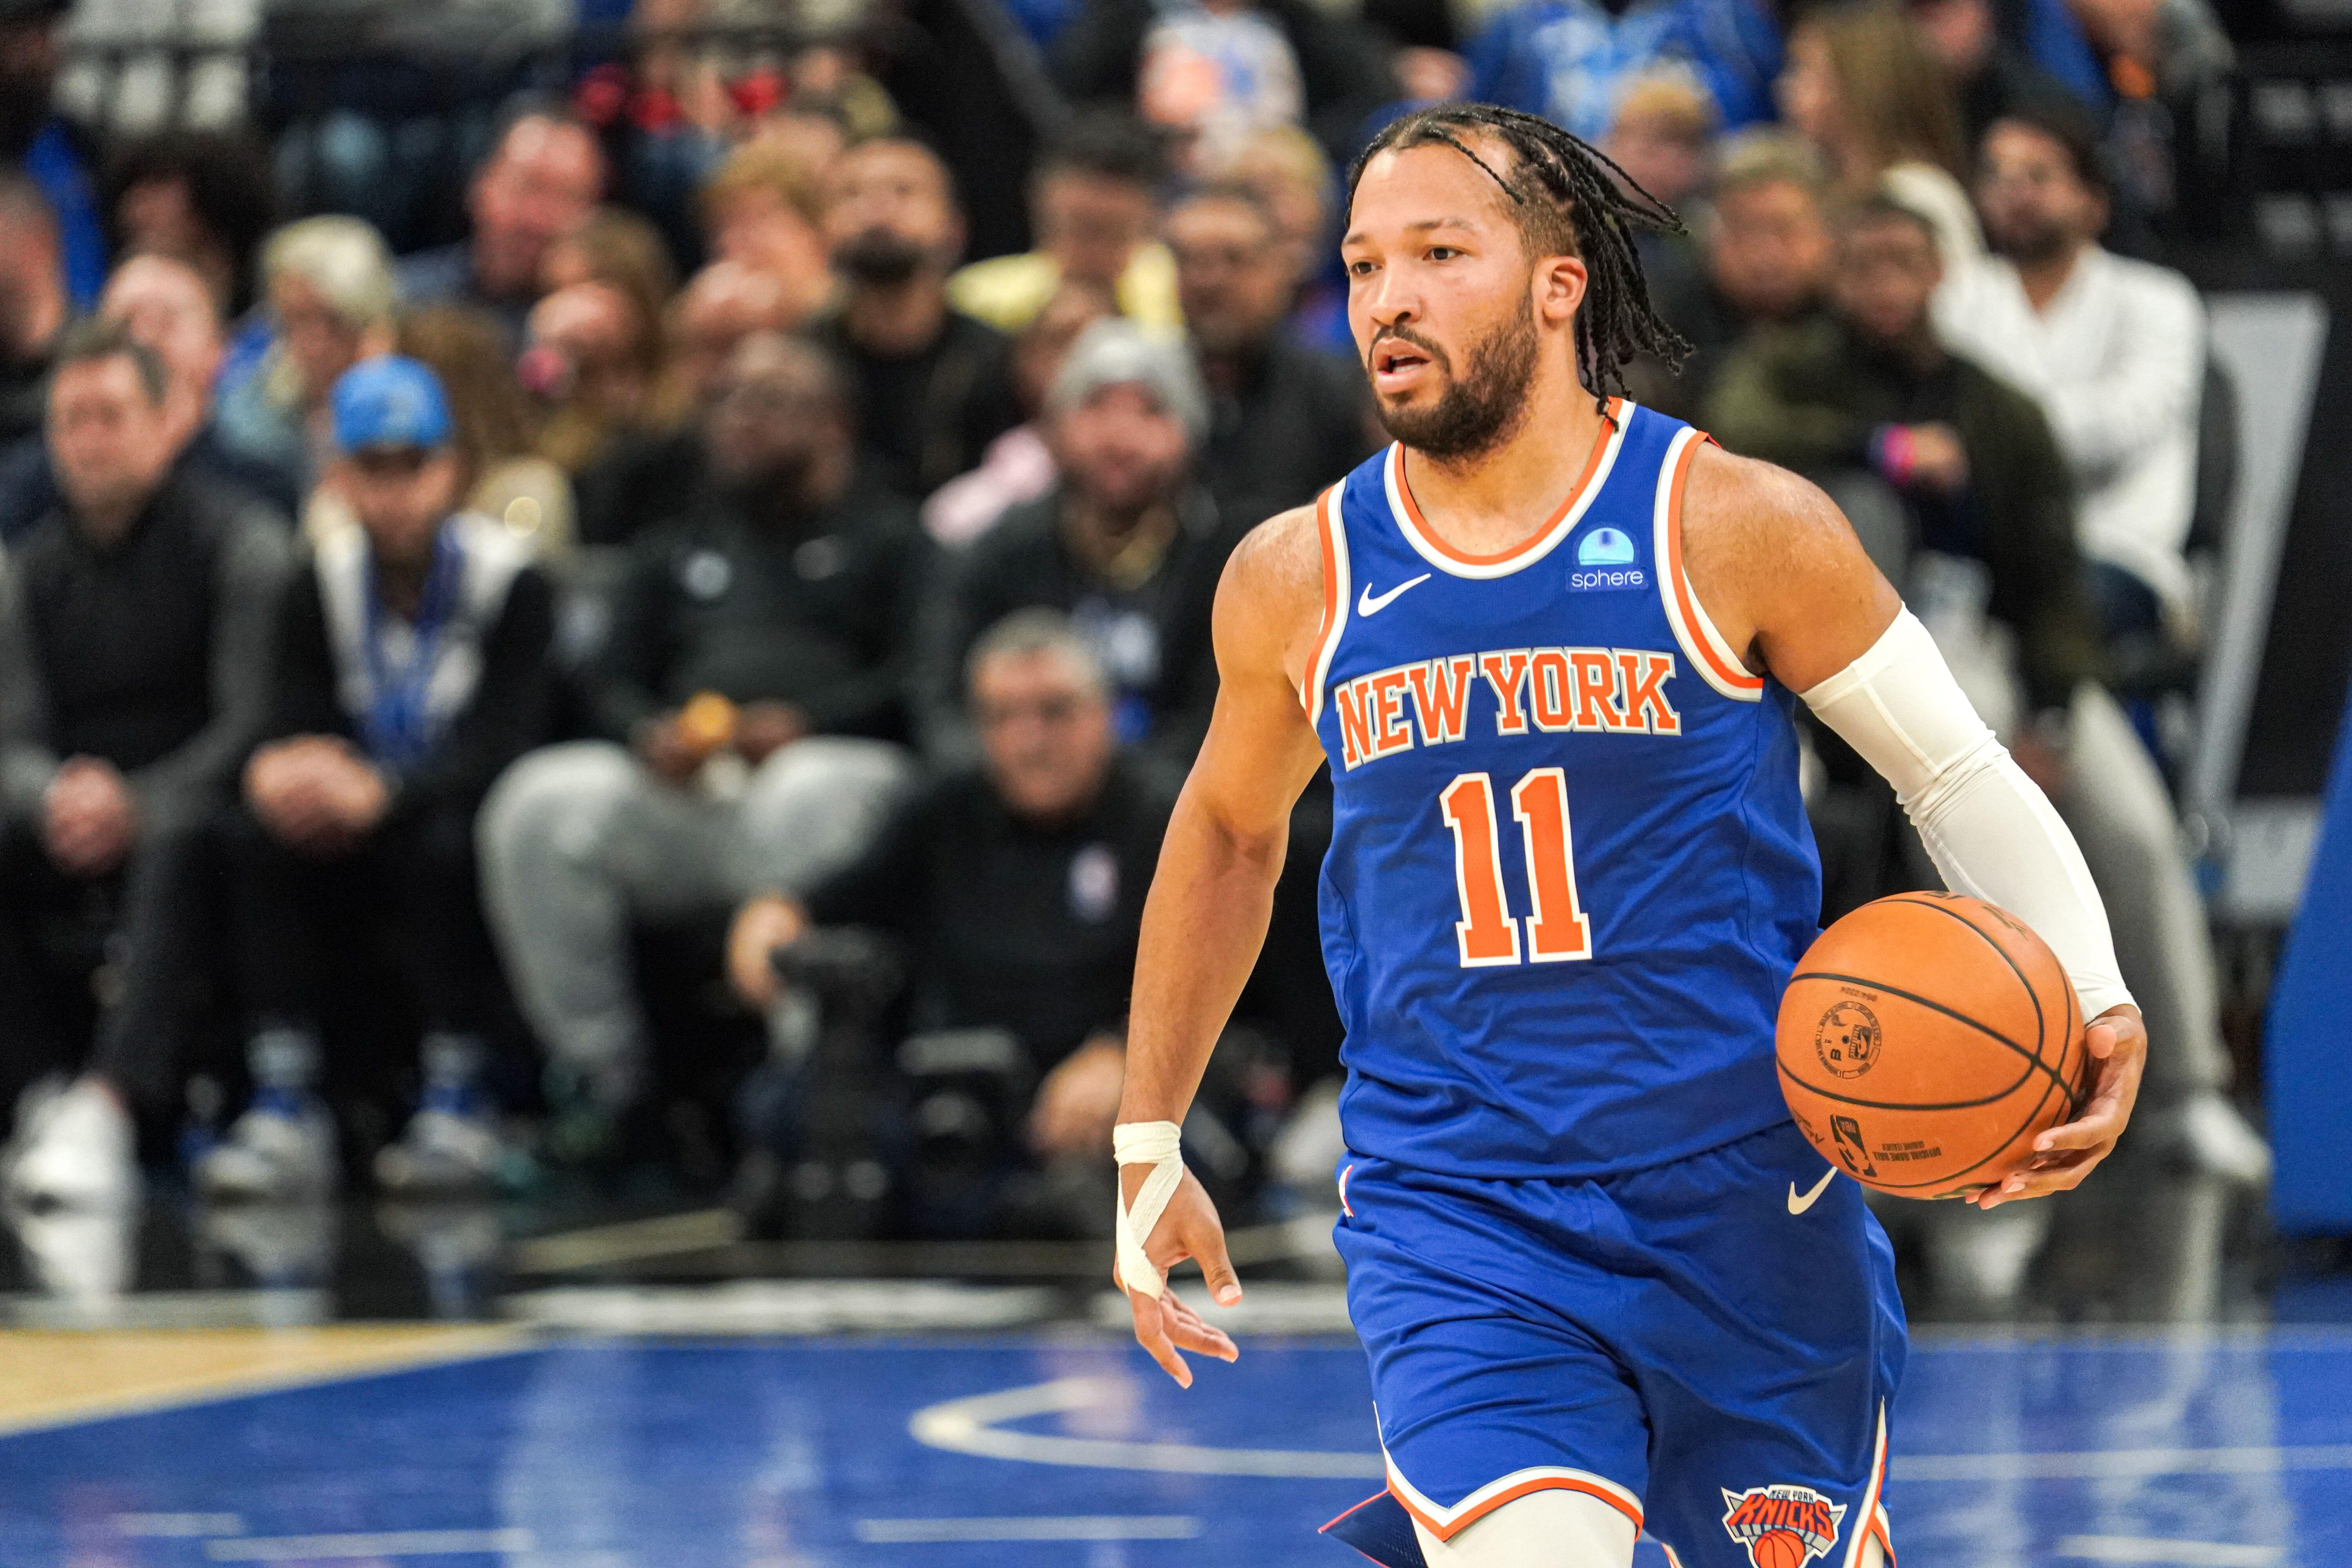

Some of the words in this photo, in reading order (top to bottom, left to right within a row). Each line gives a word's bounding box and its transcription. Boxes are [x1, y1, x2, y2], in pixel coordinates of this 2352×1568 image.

[1572, 569, 1643, 590] sphere
[1335, 652, 1476, 772] NEW
[1478, 646, 1682, 736] YORK
[1439, 767, 1592, 968] 11
[1840, 1120, 1857, 1133] NBA
[1873, 1152, 1889, 1161] BALL
[1769, 1490, 1790, 1499] NEW
[1793, 1491, 1814, 1503] YORK
[1727, 1493, 1835, 1543] KNICKS
